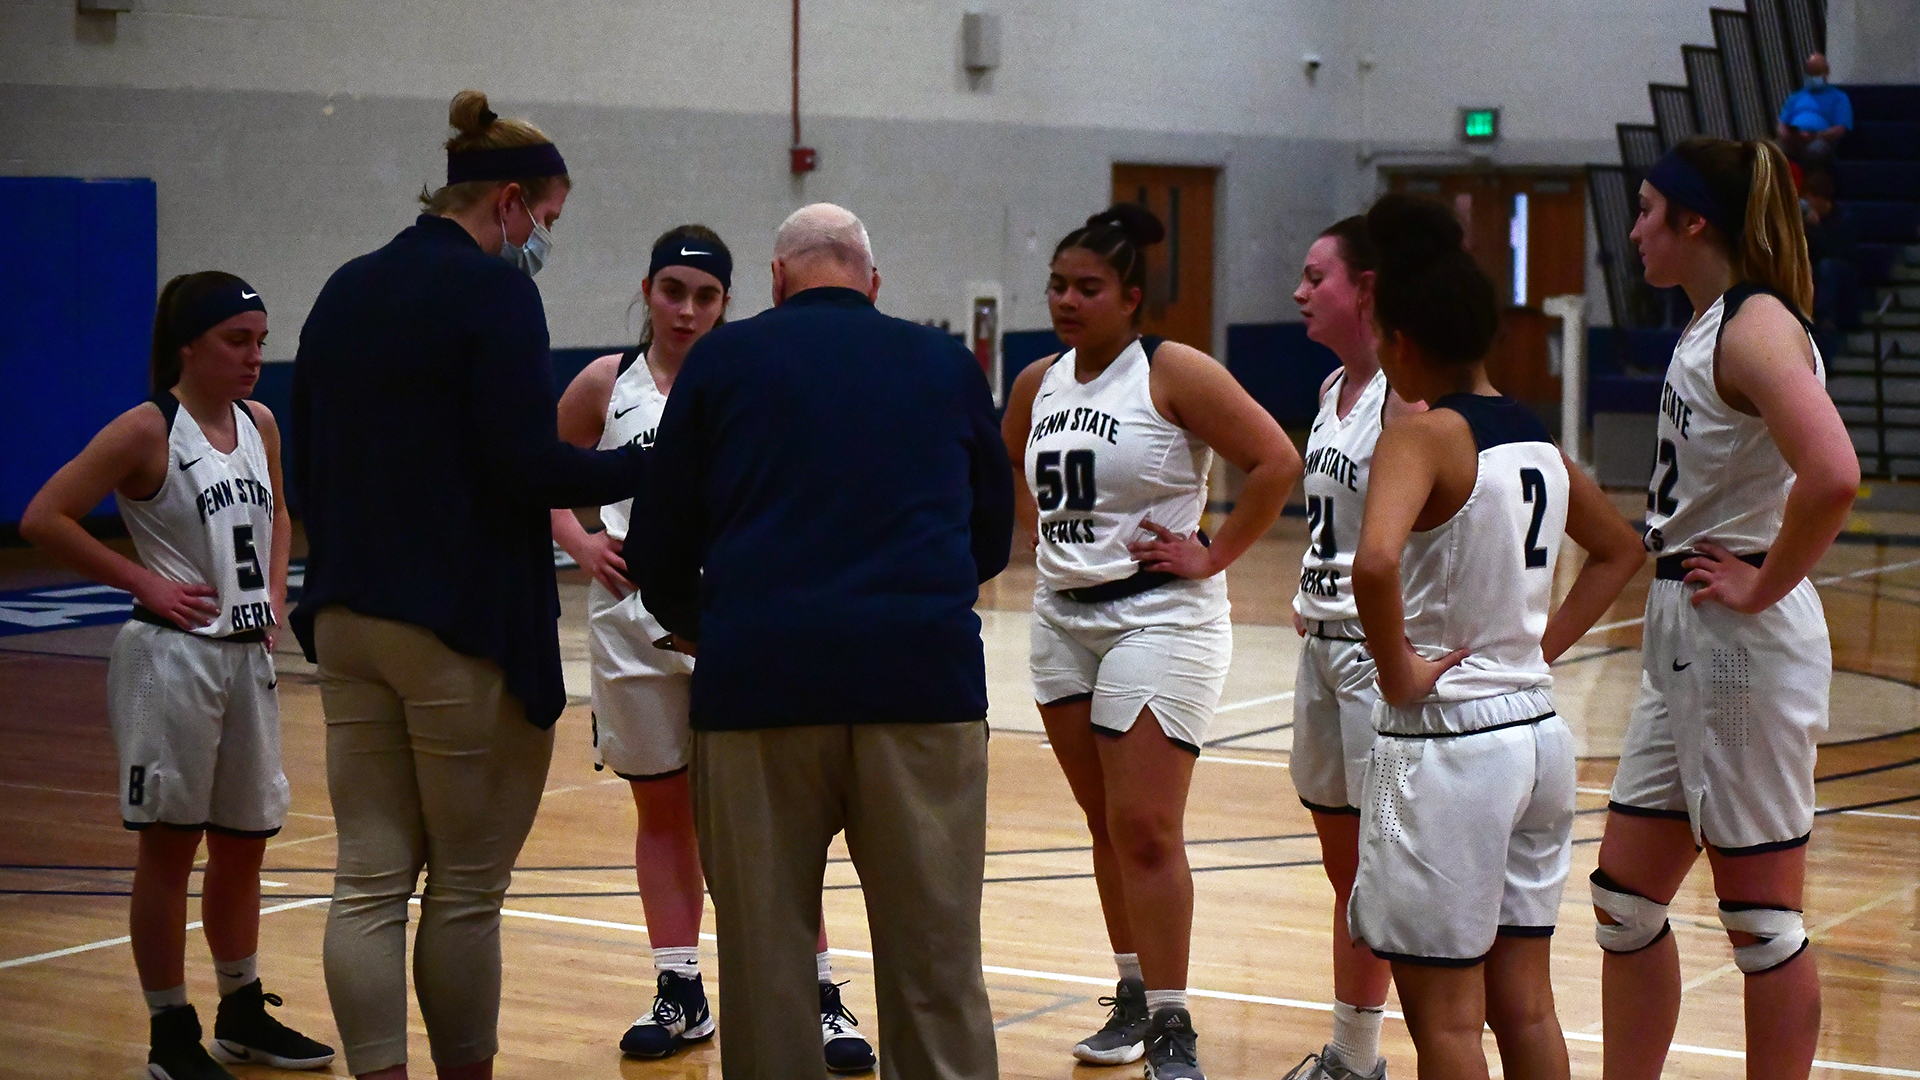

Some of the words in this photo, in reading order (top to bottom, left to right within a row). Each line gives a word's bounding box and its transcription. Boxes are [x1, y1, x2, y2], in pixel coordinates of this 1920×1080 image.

[1029, 409, 1071, 449] PENN
[1071, 407, 1120, 445] STATE
[1036, 449, 1097, 512] 50
[1320, 447, 1358, 492] STATE
[1647, 438, 1680, 518] 2
[196, 479, 234, 525] PENN
[1519, 467, 1548, 570] 2
[232, 524, 265, 591] 5
[231, 601, 276, 632] BERK
[129, 765, 146, 806] B
